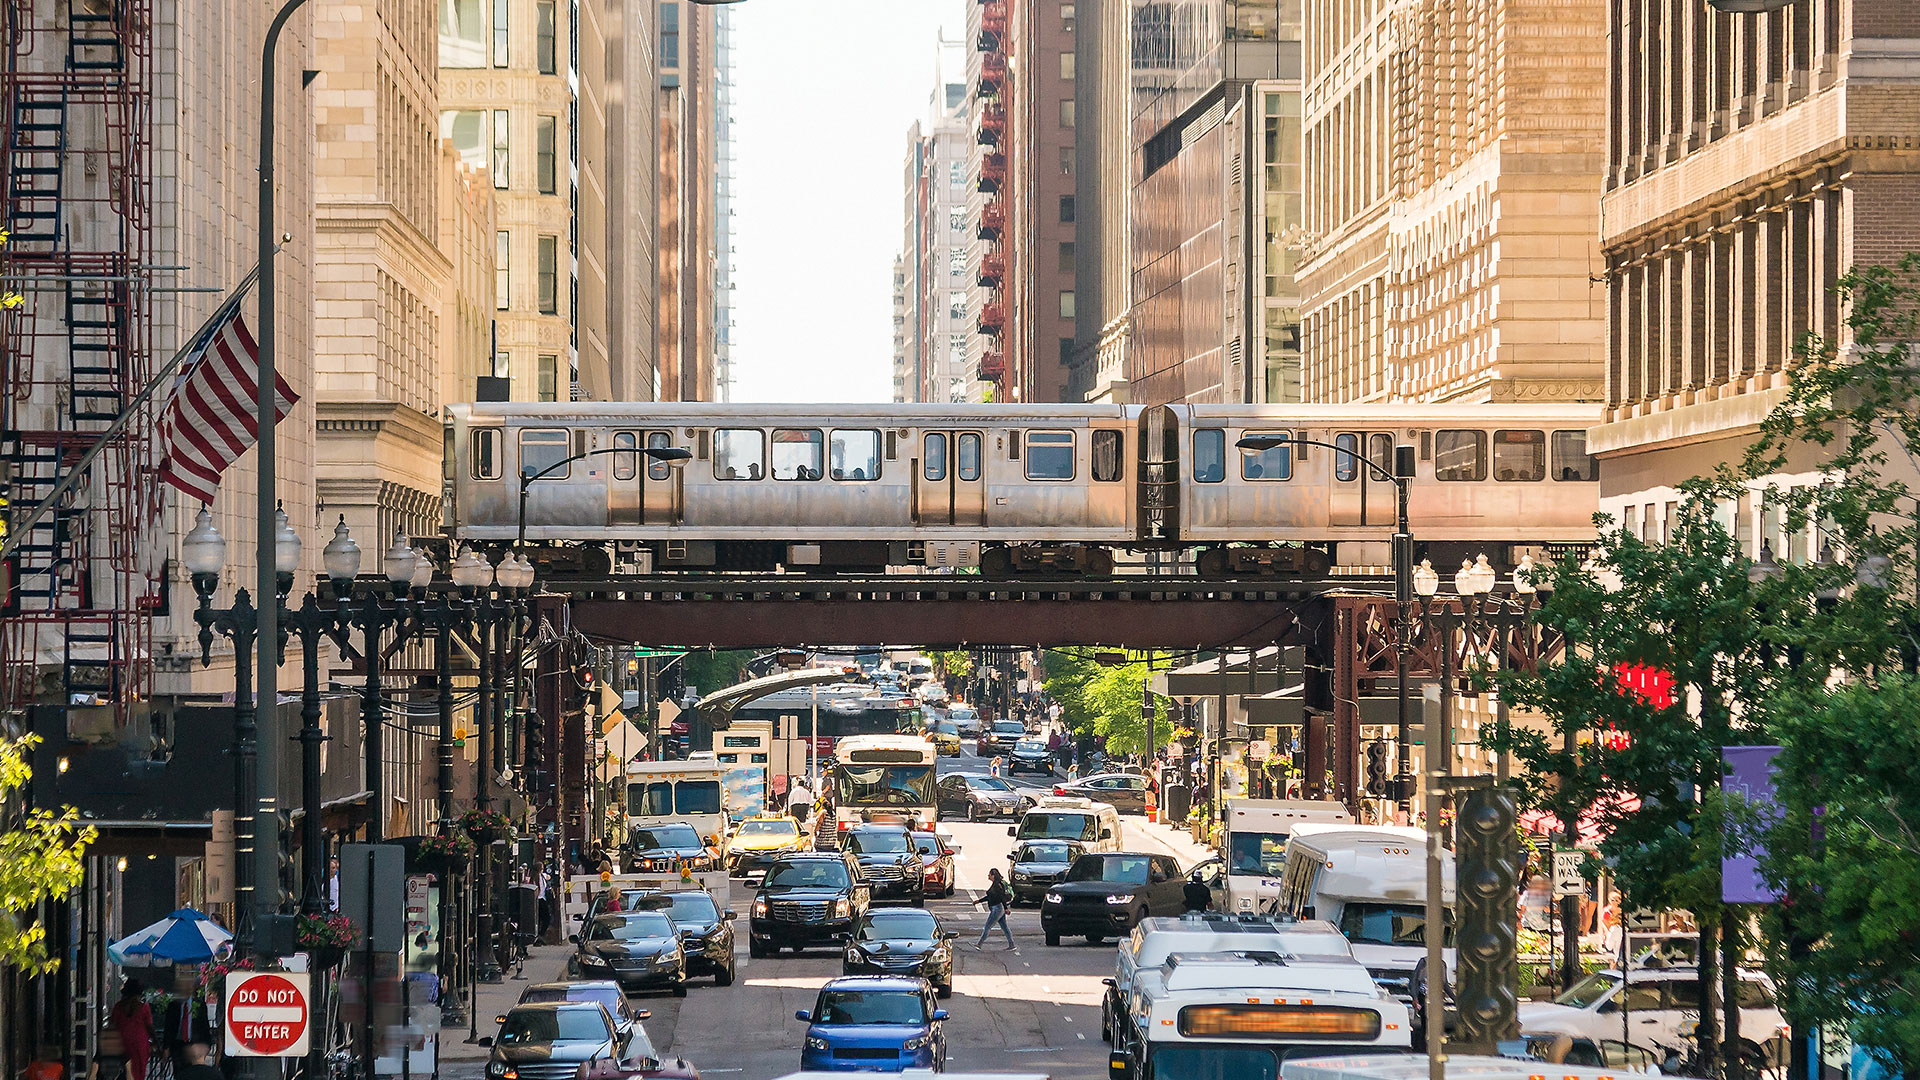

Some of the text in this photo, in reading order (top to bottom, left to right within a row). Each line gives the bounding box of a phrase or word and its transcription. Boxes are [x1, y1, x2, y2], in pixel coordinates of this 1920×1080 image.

[1558, 856, 1581, 867] ONE
[1557, 868, 1581, 878] WAY
[239, 989, 296, 1004] DO NOT
[244, 1025, 290, 1039] ENTER
